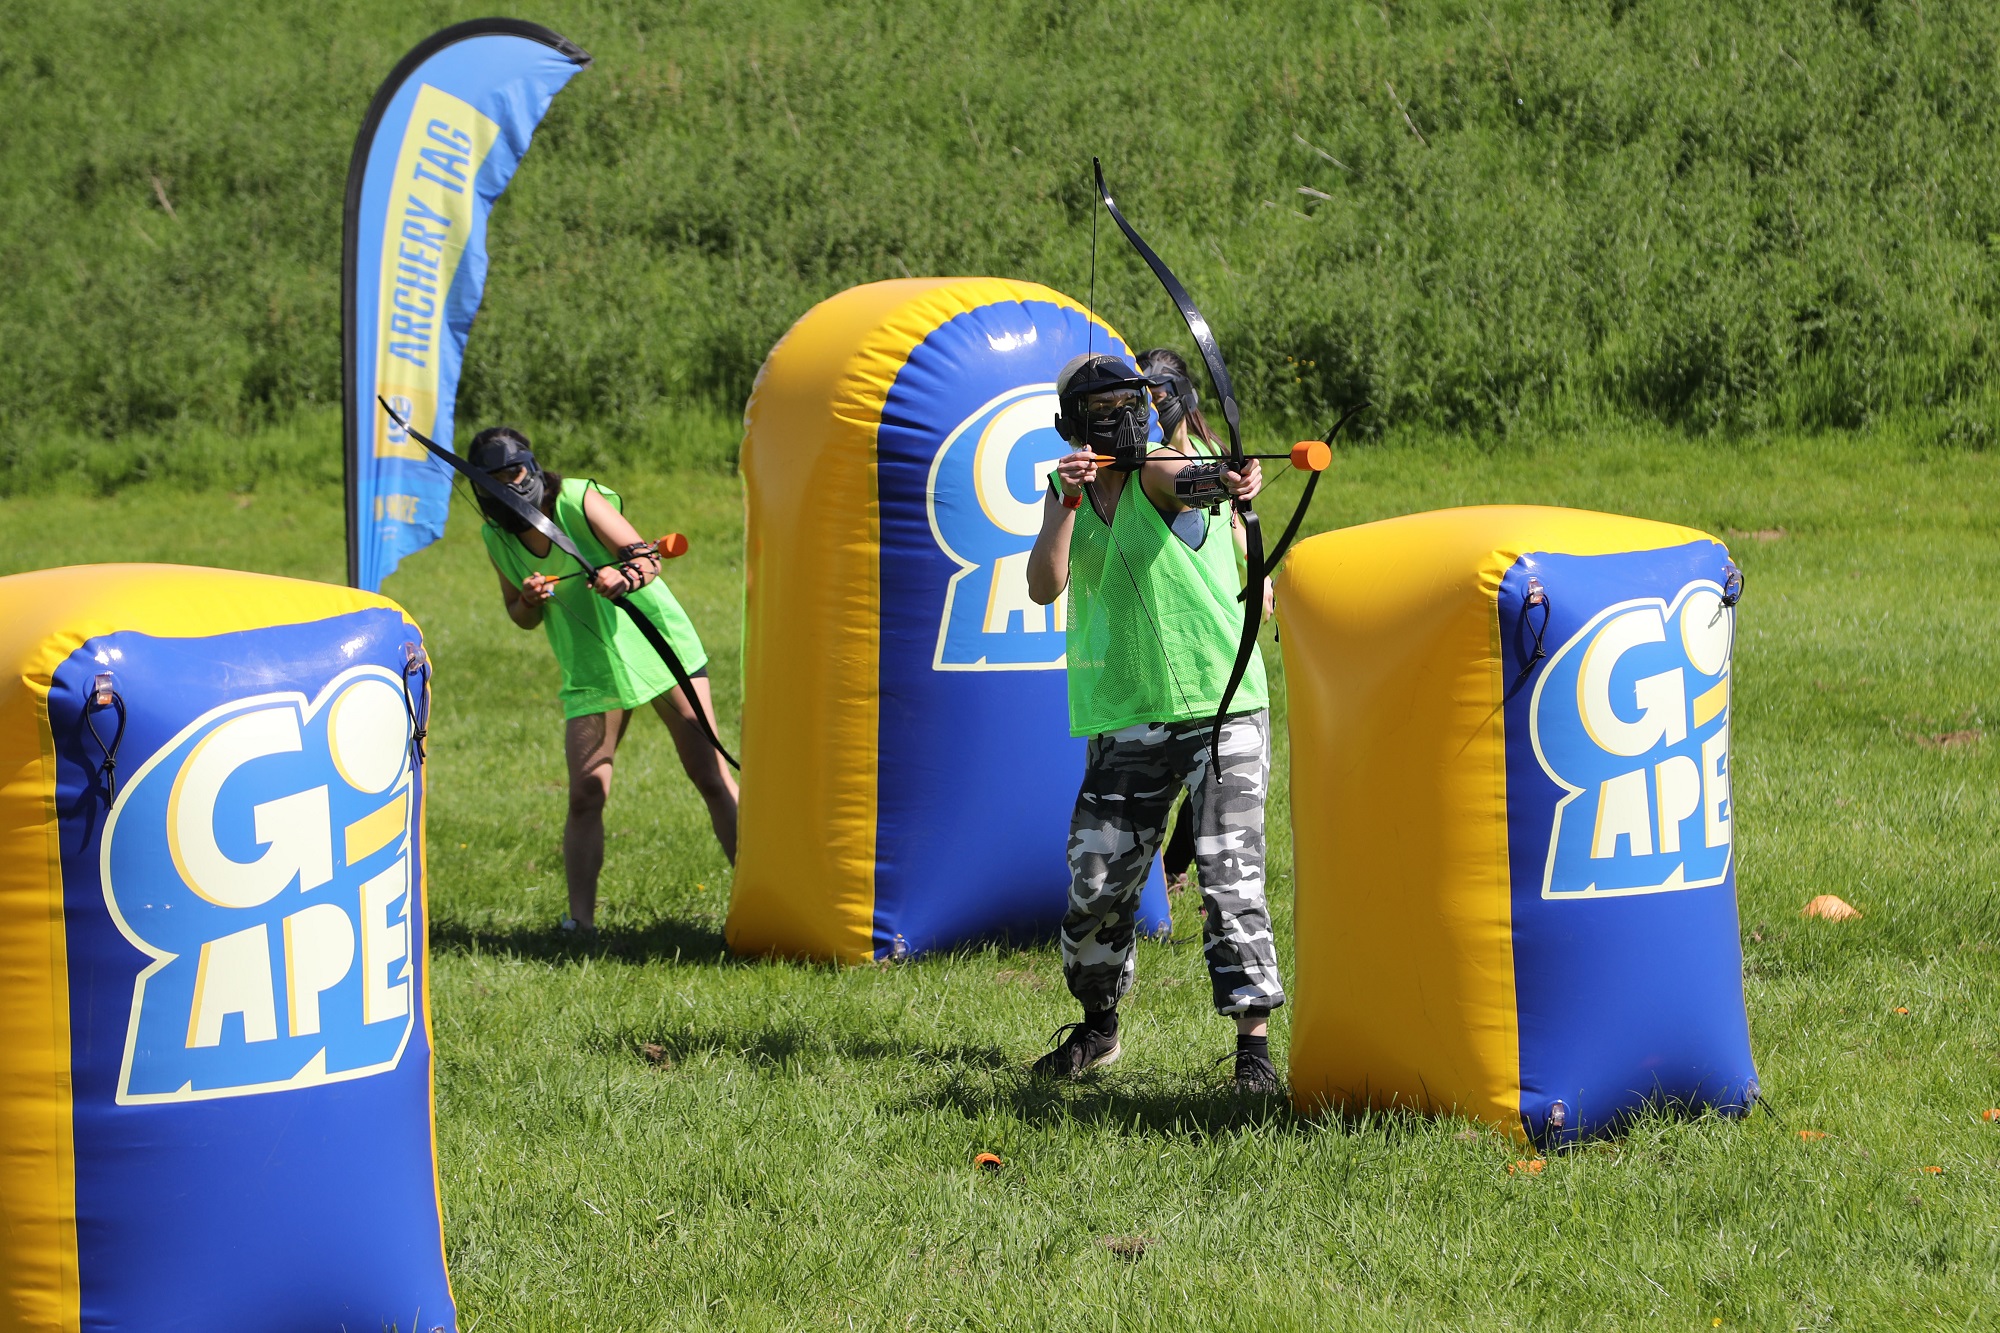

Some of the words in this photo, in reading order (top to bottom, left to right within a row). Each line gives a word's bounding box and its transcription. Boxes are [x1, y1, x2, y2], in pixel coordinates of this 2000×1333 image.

[413, 118, 472, 194] TAG
[389, 193, 452, 368] ARCHERY
[1184, 304, 1212, 352] SNKE
[1590, 726, 1731, 860] APE
[185, 855, 409, 1049] APE
